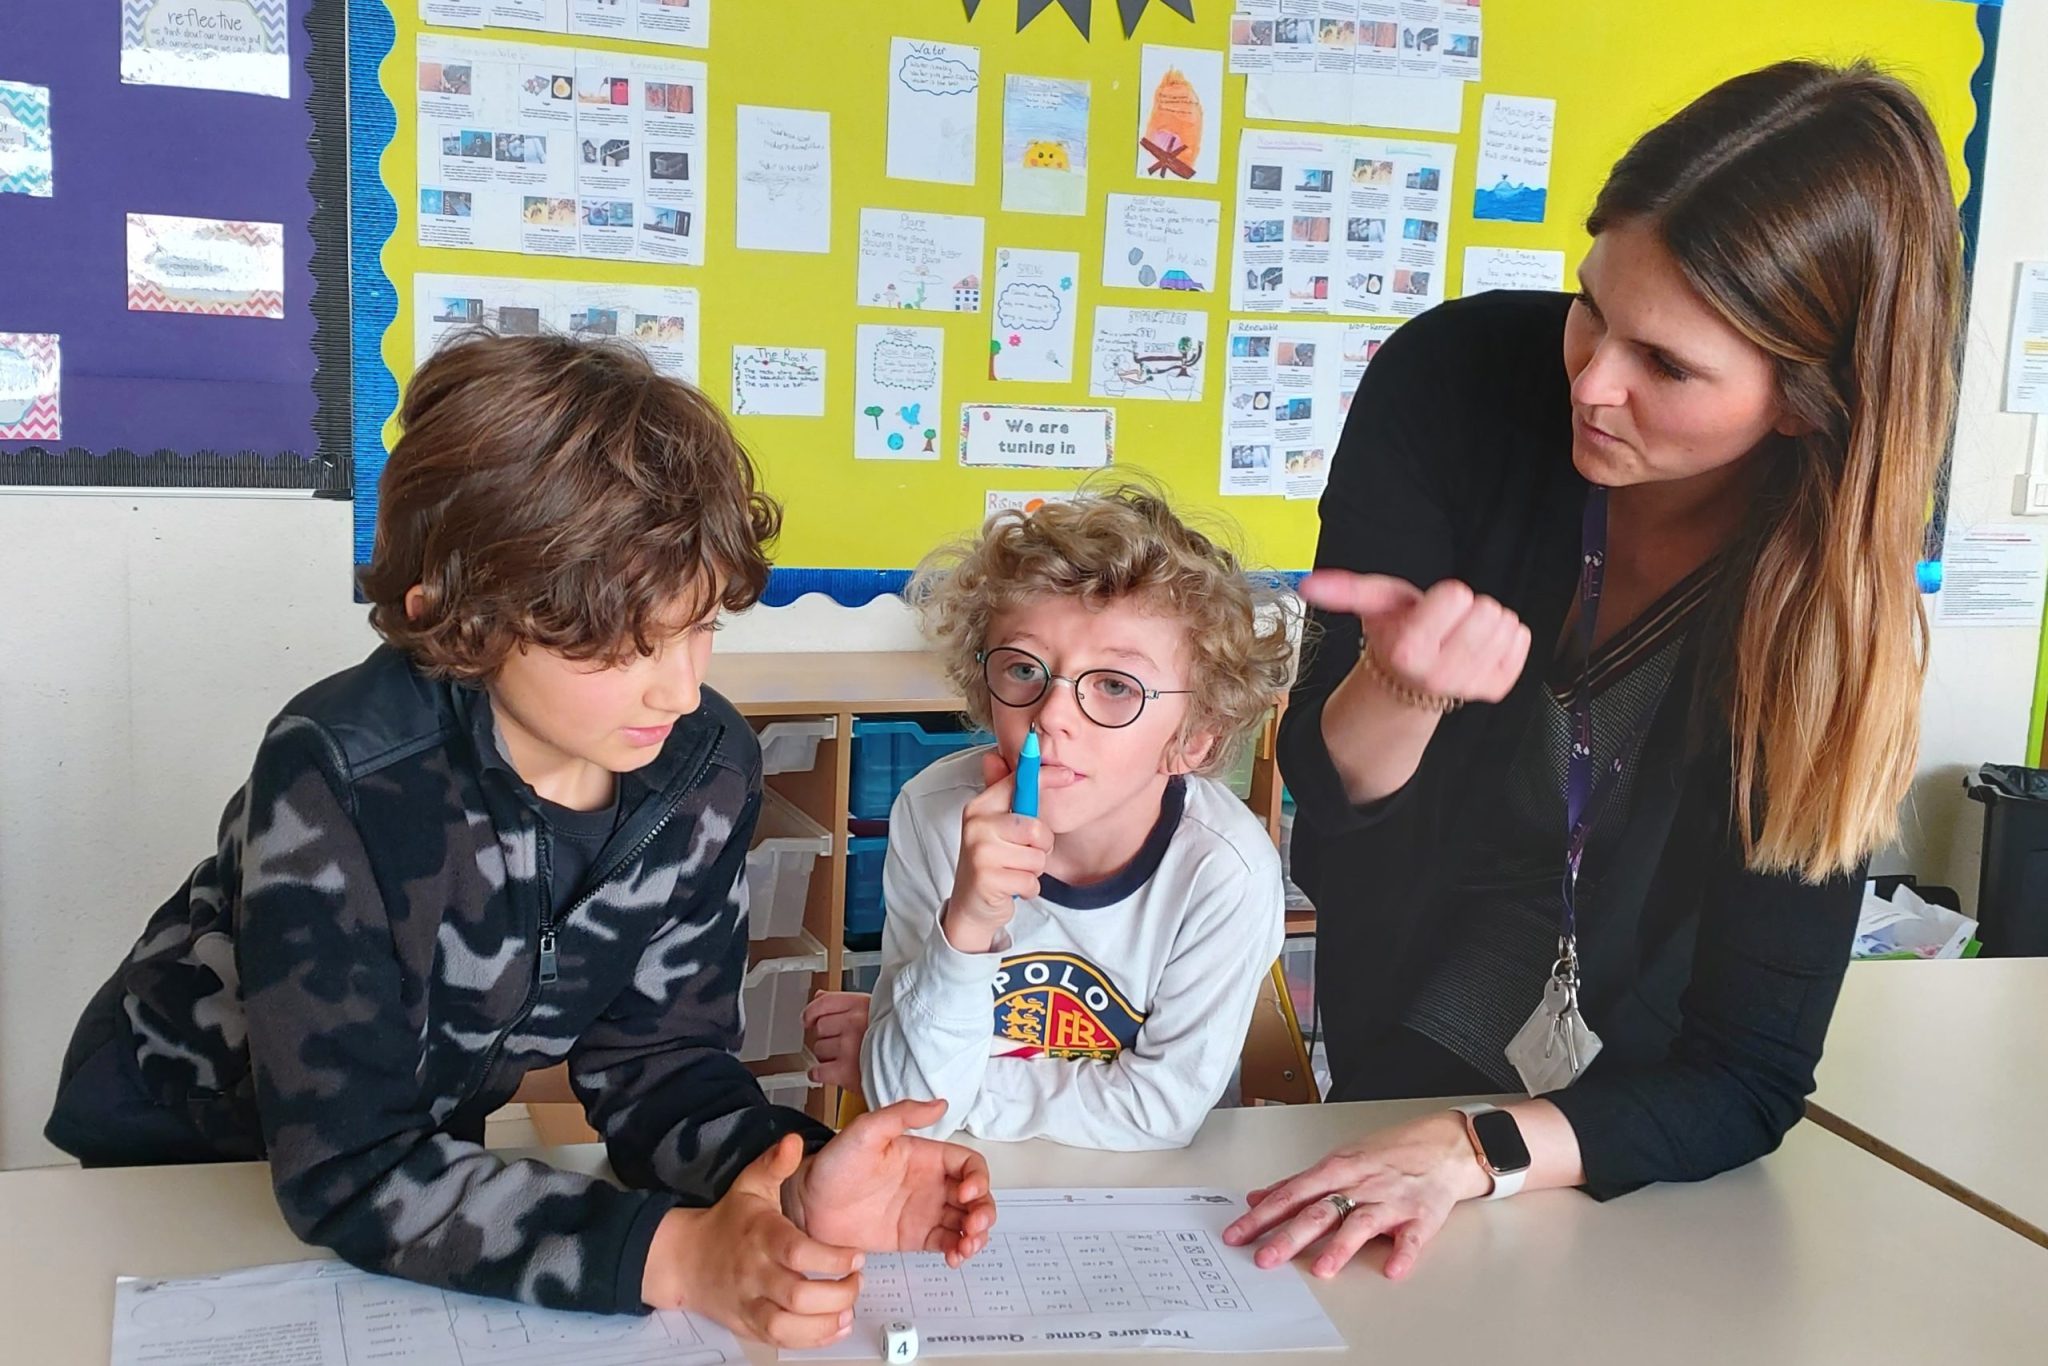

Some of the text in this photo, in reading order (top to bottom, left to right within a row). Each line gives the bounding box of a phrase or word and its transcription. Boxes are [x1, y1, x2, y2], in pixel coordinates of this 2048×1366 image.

[168, 8, 242, 31] reflective
[908, 42, 946, 55] Water
[1238, 322, 1279, 331] Renewable
[755, 347, 778, 360] The
[1005, 418, 1070, 434] We are
[998, 440, 1076, 455] tuning in
[994, 962, 1109, 1011] POLO
[926, 1333, 1025, 1344] Questions
[1045, 1330, 1102, 1341] Game
[1108, 1328, 1194, 1340] Treasure
[897, 1340, 908, 1356] 4
